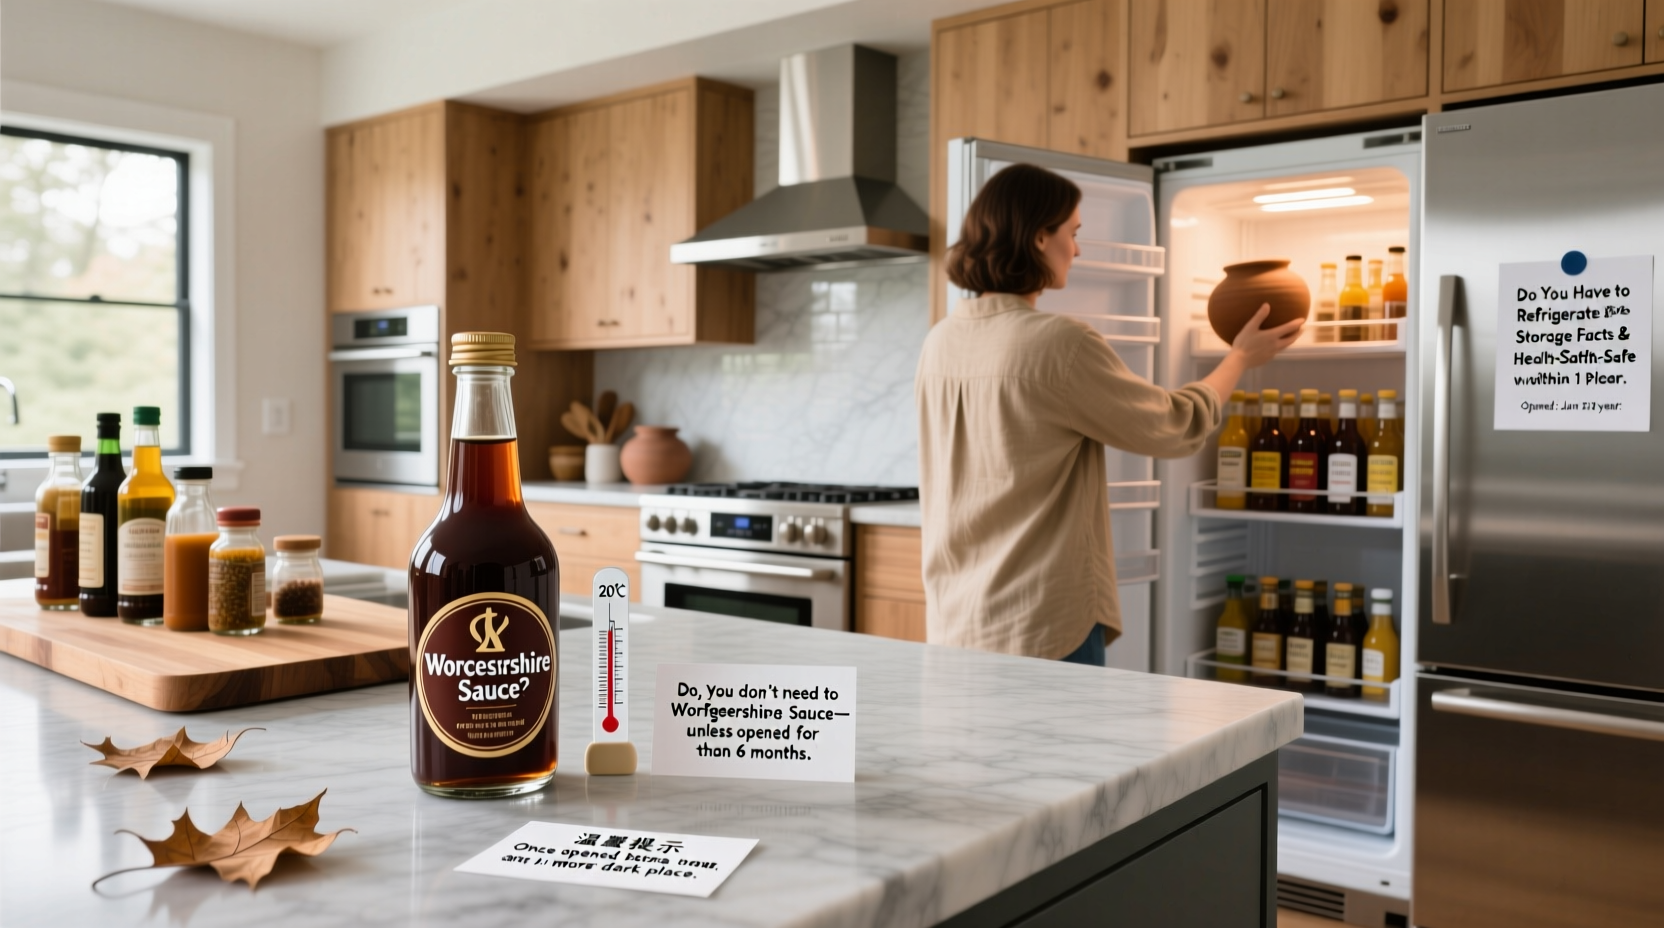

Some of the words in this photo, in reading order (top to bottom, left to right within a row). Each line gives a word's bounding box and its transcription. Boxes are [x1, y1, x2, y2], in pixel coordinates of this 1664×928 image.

[1517, 287, 1537, 302] Do
[1540, 286, 1568, 300] You
[1573, 284, 1611, 299] Have
[1615, 284, 1630, 297] to
[1517, 307, 1600, 325] Refrigerate
[1515, 330, 1573, 346] Storage
[1577, 327, 1614, 342] Facts
[1618, 326, 1630, 341] &
[1575, 372, 1581, 386] 1
[458, 677, 530, 702] Sauce?
[677, 682, 702, 699] Do,
[706, 684, 734, 700] you
[738, 684, 778, 699] don't
[782, 686, 819, 700] need
[823, 687, 839, 701] to
[686, 724, 733, 738] unless
[737, 725, 790, 742] opened
[796, 725, 819, 740] for
[696, 742, 731, 758] than
[736, 744, 746, 758] 6
[750, 744, 812, 761] months.
[513, 842, 556, 855] Once
[560, 847, 620, 861] opened
[601, 861, 641, 874] dark
[644, 866, 697, 879] place.
